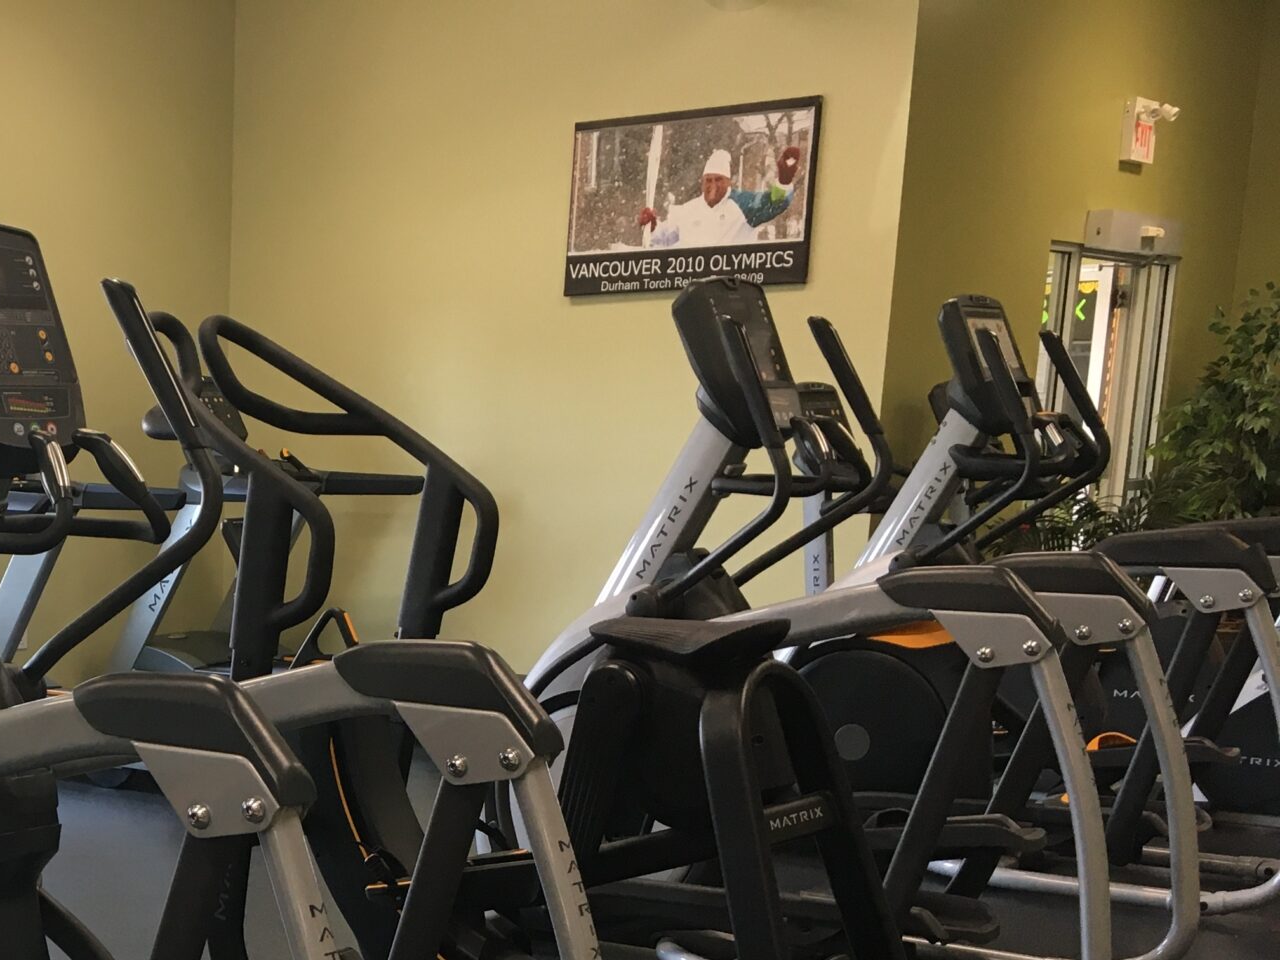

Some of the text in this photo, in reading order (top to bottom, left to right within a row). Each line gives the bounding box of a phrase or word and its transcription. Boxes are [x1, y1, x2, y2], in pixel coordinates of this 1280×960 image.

[569, 250, 795, 280] VANCOUVER 2010 OLYMPICS
[600, 279, 640, 292] Durham
[643, 277, 671, 289] Torch
[674, 276, 697, 288] Rel
[896, 462, 952, 546] MATRIX
[635, 476, 698, 579] MATRIX
[1239, 756, 1280, 768] TRIX
[769, 806, 824, 831] MATRIX
[558, 839, 601, 960] MATRIX
